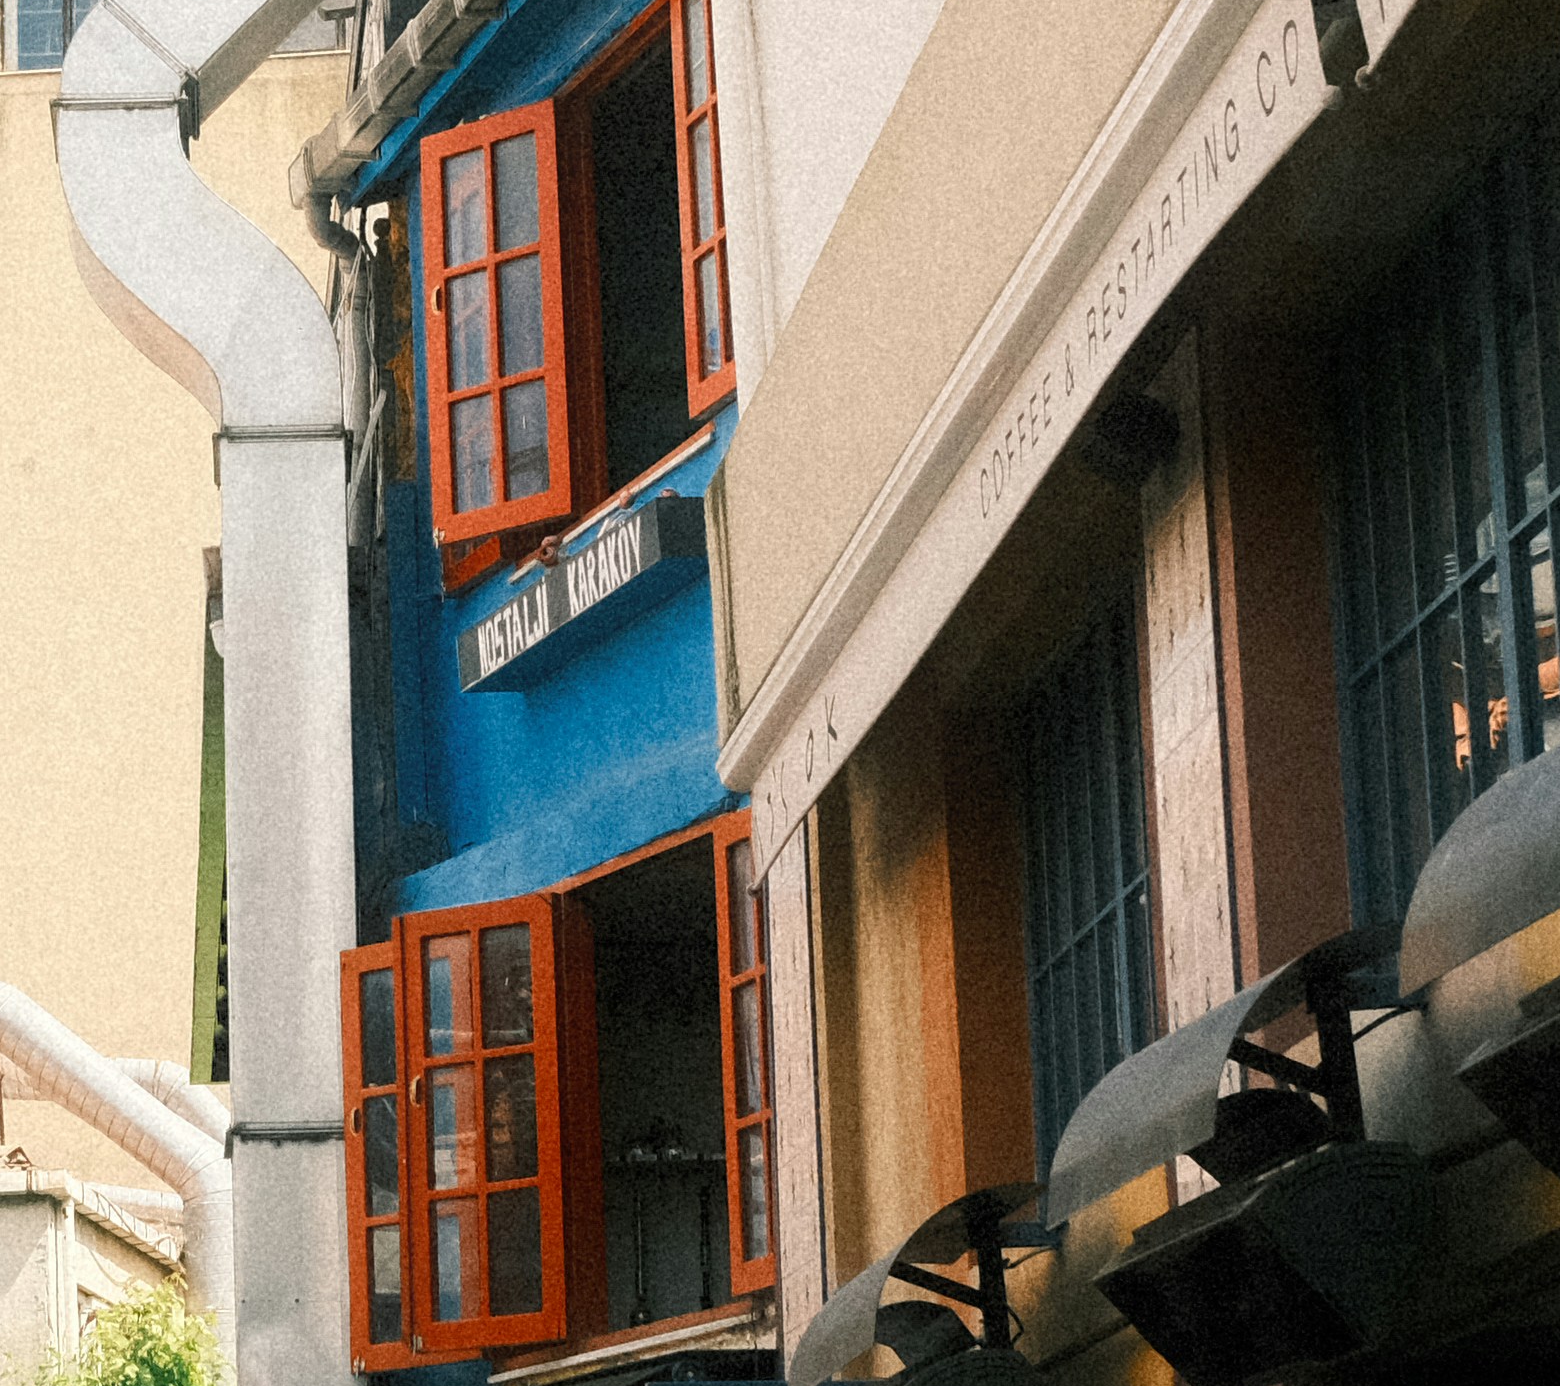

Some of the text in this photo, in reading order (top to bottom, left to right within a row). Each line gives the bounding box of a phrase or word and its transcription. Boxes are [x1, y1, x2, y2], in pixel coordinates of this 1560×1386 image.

[980, 19, 1300, 520] COFFEE & RESTARTING CO
[566, 515, 642, 617] KARAKÖY
[805, 693, 838, 783] OK
